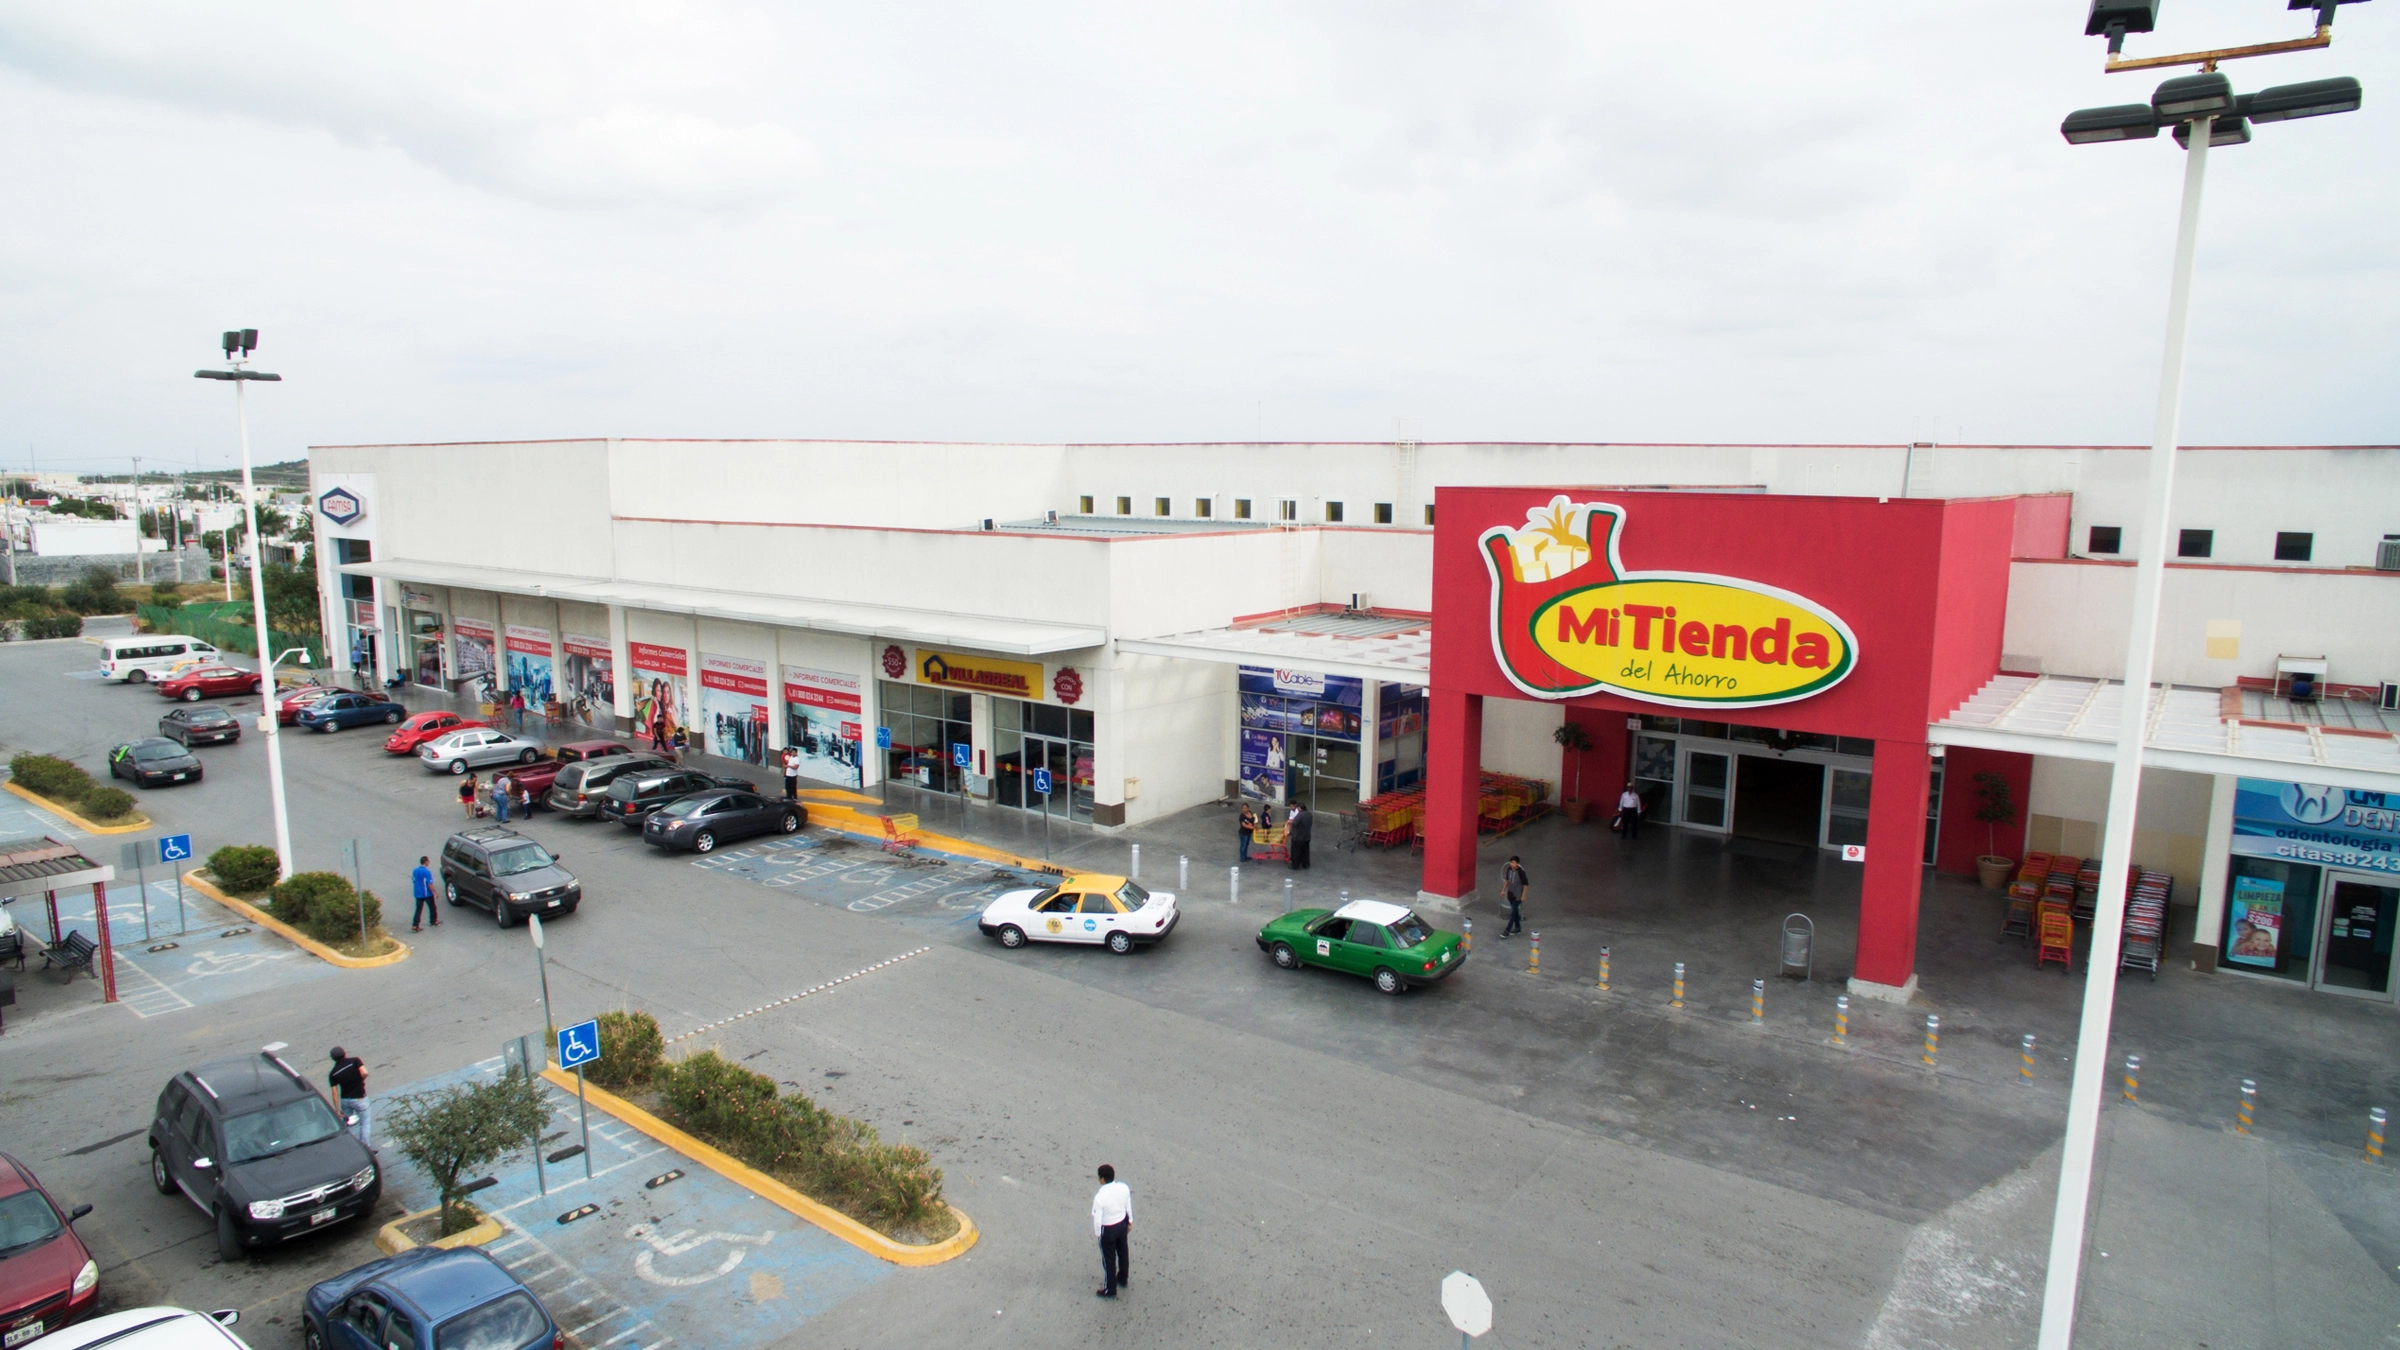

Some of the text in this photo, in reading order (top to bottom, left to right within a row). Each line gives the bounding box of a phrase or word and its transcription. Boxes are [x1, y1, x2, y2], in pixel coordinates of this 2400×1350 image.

[638, 646, 686, 661] Informes Comerciales
[708, 659, 764, 674] INFORMES COMERCIALES
[793, 671, 857, 689] INFORMES COMERCIALES
[946, 666, 1029, 690] VILLARREAL
[1620, 659, 1738, 690] del Ahorro
[1060, 683, 1073, 691] CON
[2276, 828, 2392, 853] odontologia
[2237, 889, 2282, 902] LIMPIEZA
[2247, 913, 2273, 926] $200
